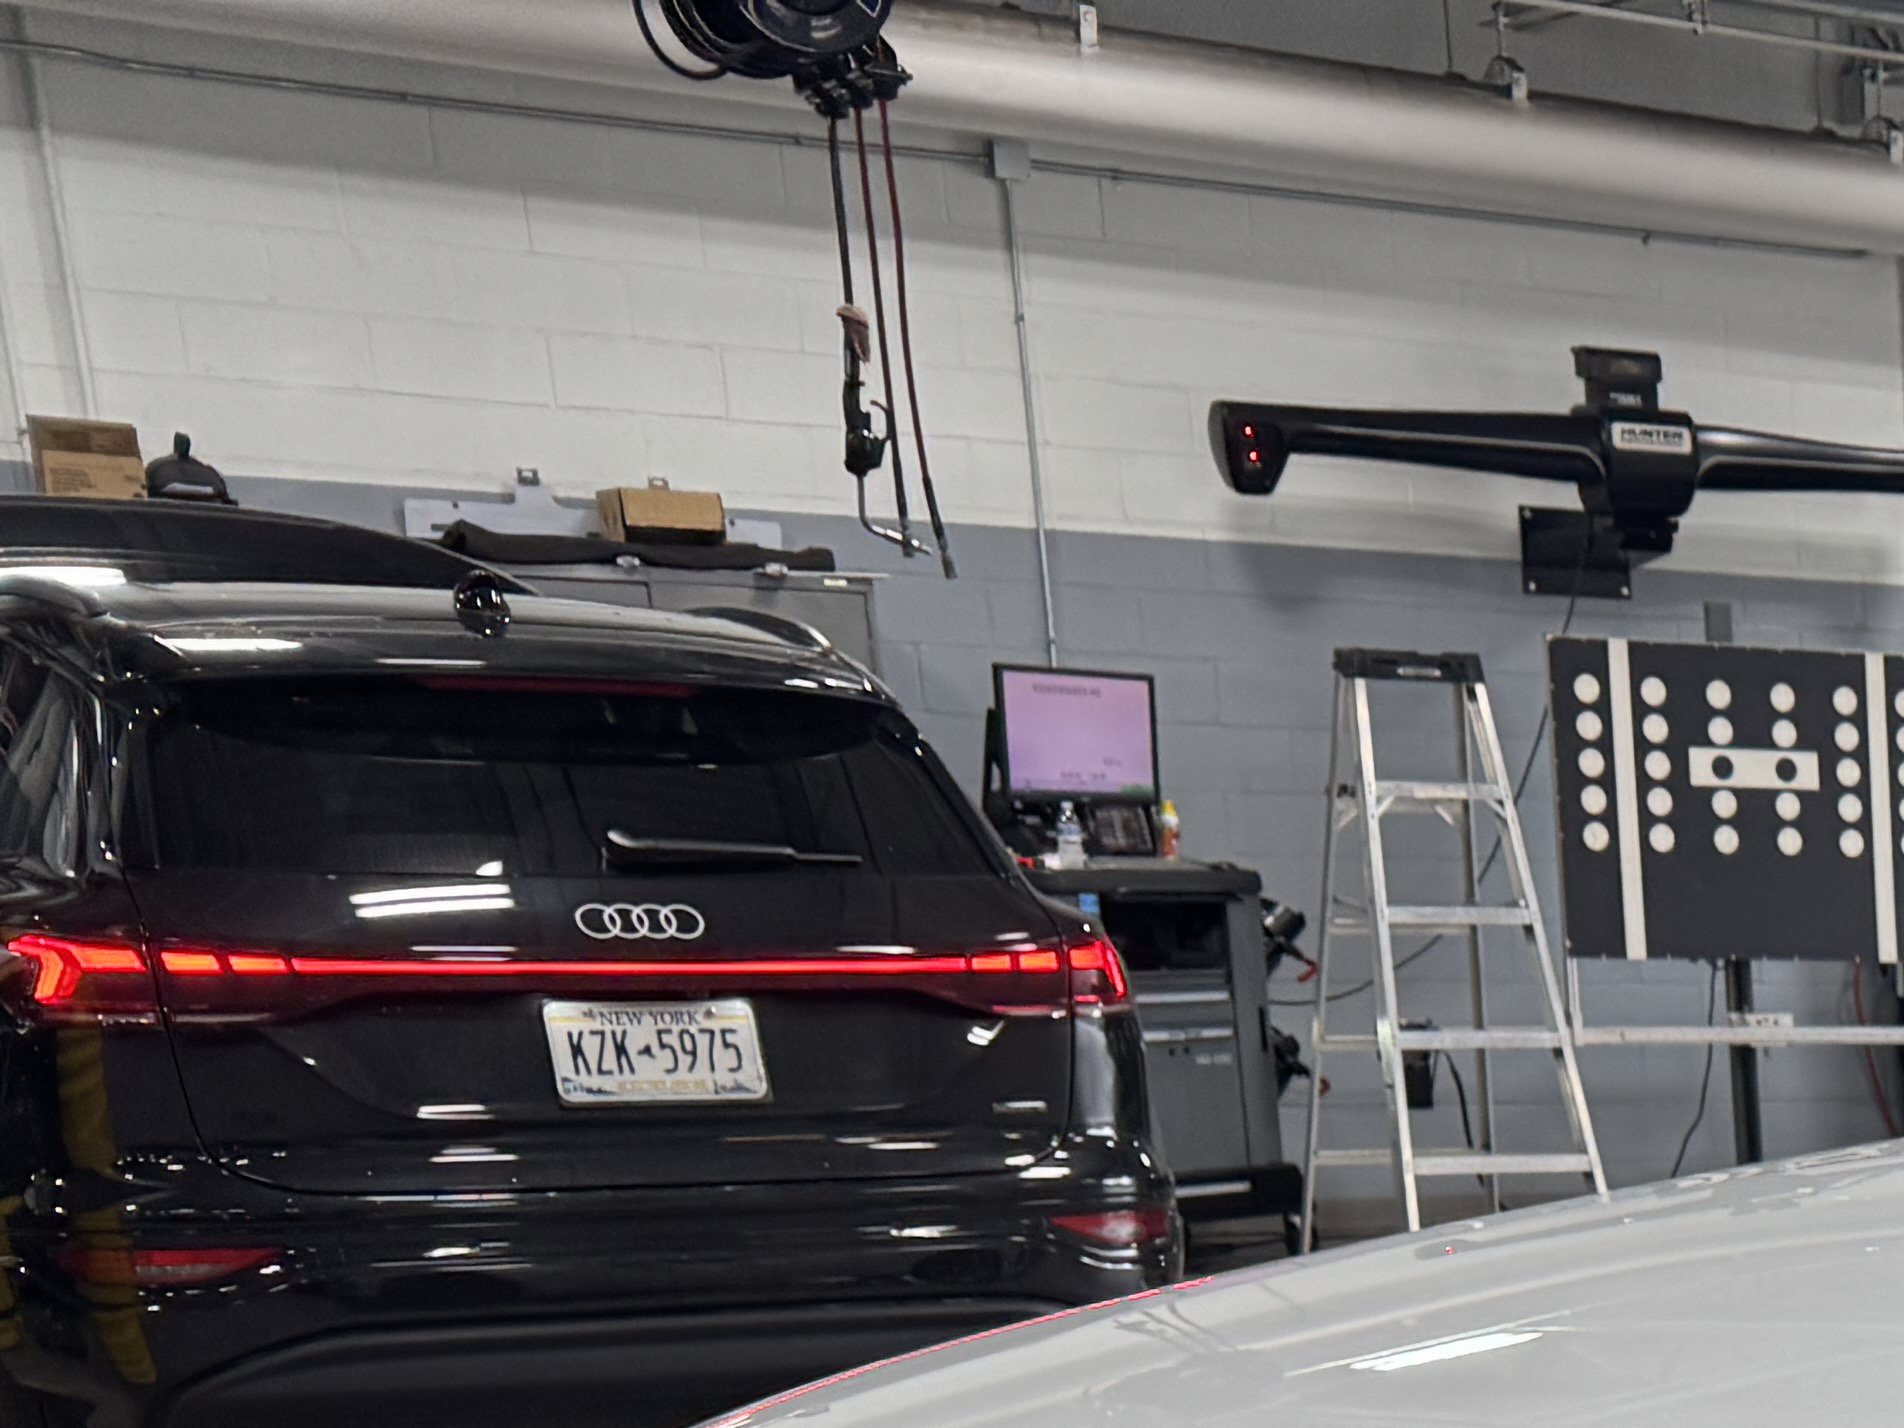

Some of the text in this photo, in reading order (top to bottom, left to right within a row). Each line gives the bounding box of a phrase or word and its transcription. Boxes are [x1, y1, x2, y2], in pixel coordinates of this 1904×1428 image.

[1620, 428, 1683, 440] HUNTER
[600, 1009, 700, 1026] NEW YORK
